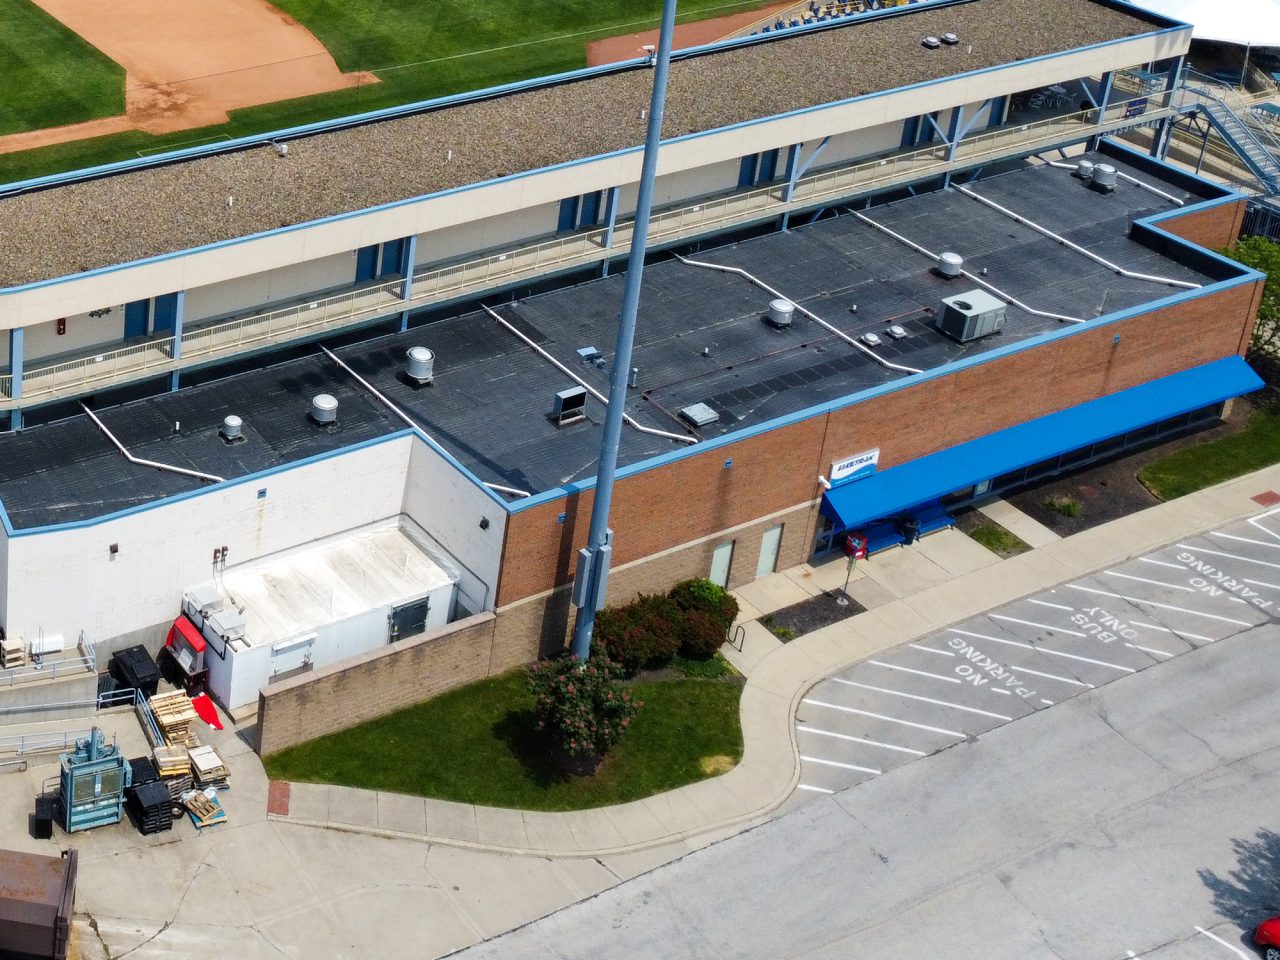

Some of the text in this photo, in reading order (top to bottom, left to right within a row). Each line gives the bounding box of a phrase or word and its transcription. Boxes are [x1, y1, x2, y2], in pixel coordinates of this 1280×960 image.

[1176, 551, 1274, 609] PARKING
[1188, 576, 1225, 598] NO
[1070, 613, 1119, 644] BUS
[1082, 606, 1139, 640] ONLY
[948, 637, 1037, 700] PARKING
[955, 664, 989, 687] NO
